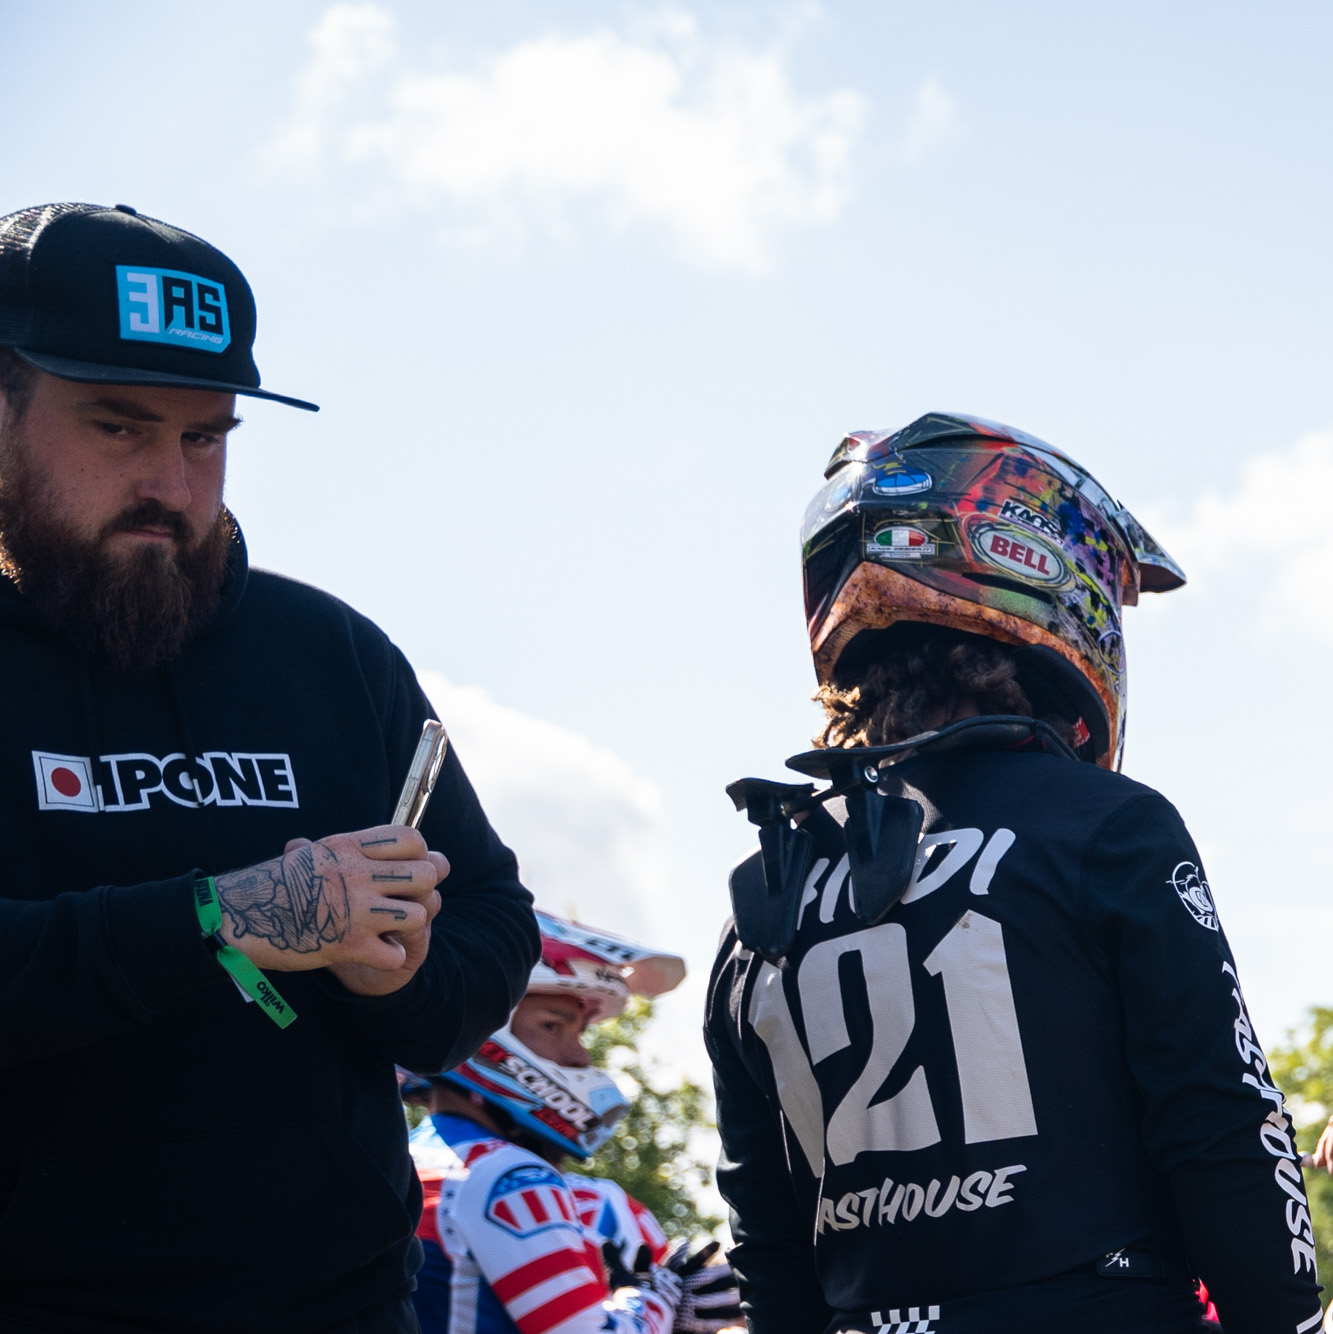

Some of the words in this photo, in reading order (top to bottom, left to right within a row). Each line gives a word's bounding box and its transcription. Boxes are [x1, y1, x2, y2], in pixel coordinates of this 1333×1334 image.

[168, 328, 224, 345] RACING
[990, 535, 1051, 577] BELL
[256, 980, 286, 1014] wilko
[816, 1165, 1027, 1236] ASTHOUSE
